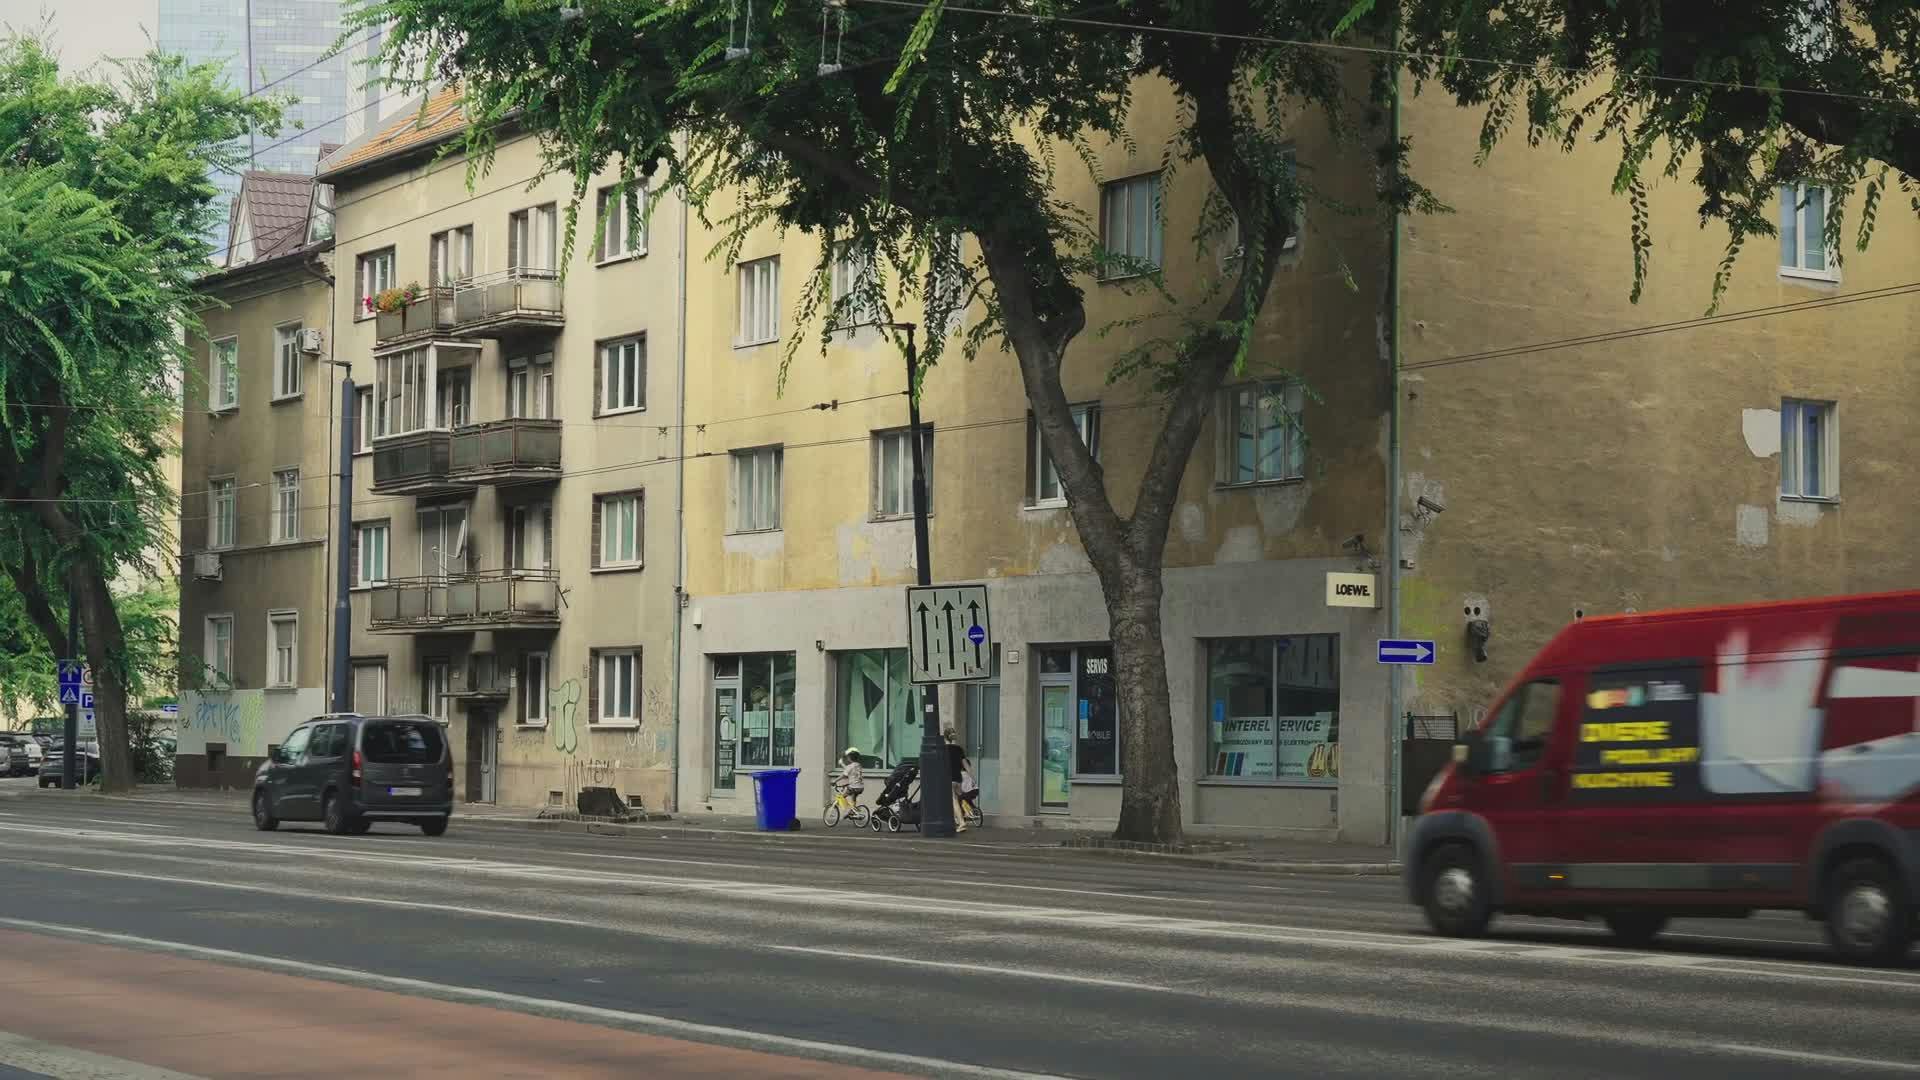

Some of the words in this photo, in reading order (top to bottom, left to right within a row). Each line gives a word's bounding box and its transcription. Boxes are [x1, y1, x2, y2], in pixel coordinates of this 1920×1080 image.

[1086, 658, 1108, 674] SERVIS
[1224, 720, 1271, 732] INTEREL
[1279, 720, 1321, 732] ERVICE
